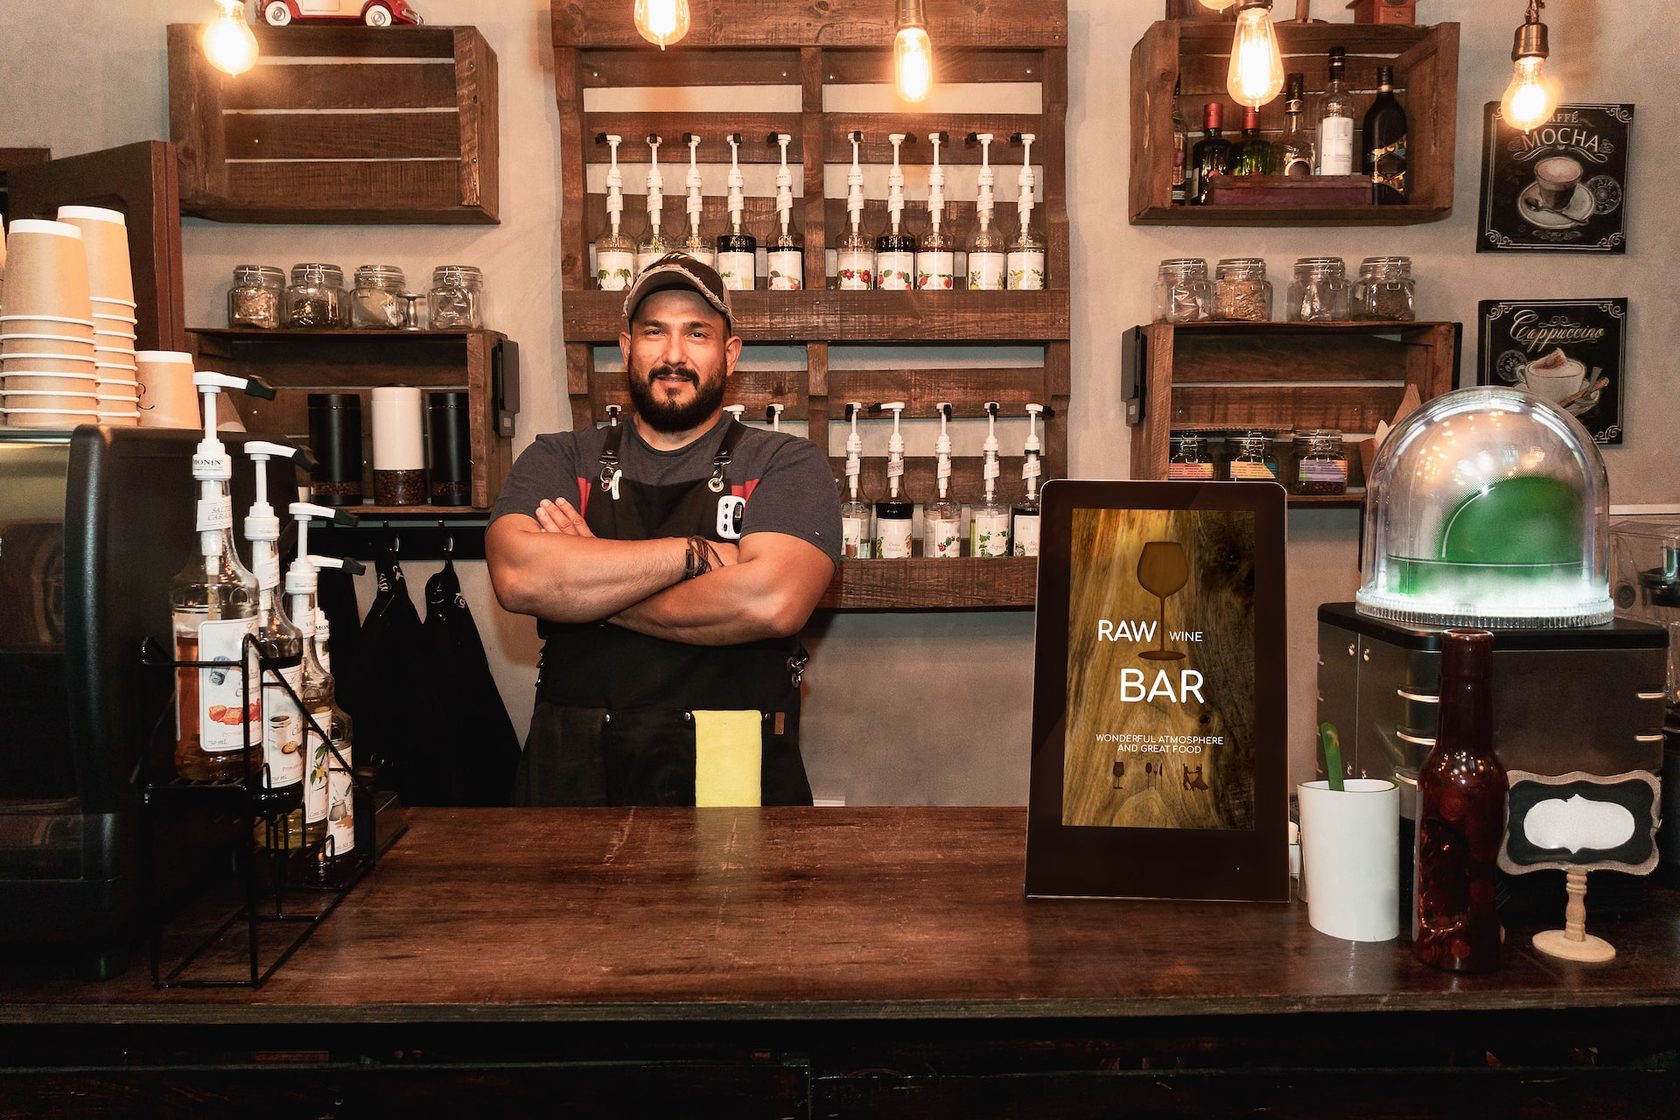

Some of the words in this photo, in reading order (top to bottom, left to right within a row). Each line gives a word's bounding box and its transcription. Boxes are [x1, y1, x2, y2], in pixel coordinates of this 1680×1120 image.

[1542, 111, 1579, 123] AFFÉ
[1521, 127, 1600, 153] MOCHA
[1510, 309, 1605, 353] Cappuccino
[1098, 619, 1157, 642] RAW
[1169, 631, 1203, 642] WINE
[1120, 668, 1204, 704] BAR
[1096, 734, 1156, 743] WONDERFUL
[1158, 736, 1224, 745] ATMOSPHERE
[1117, 744, 1138, 752] AND
[1140, 745, 1169, 753] GREAT
[1172, 746, 1202, 754] FOOD
